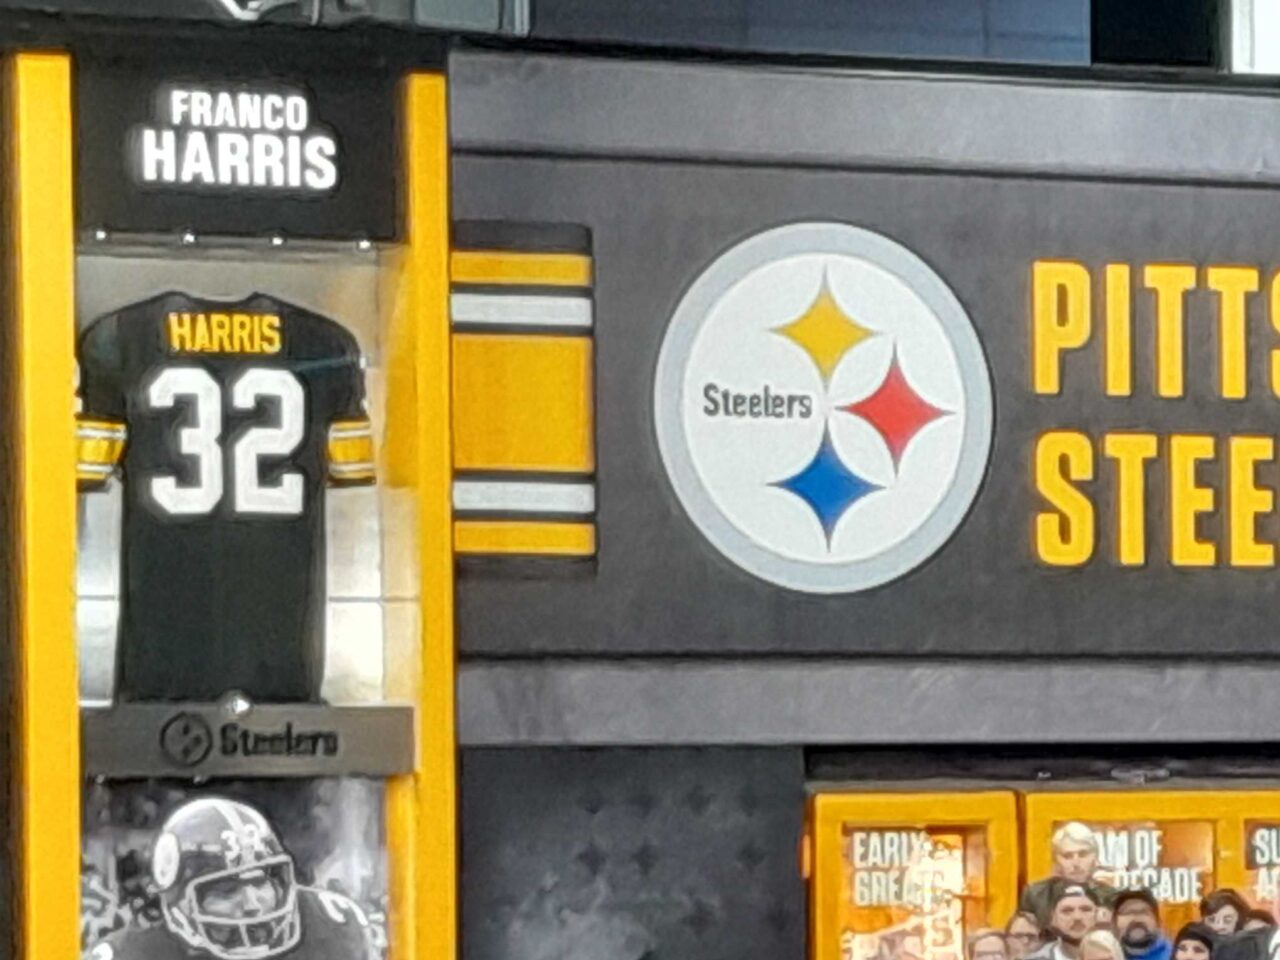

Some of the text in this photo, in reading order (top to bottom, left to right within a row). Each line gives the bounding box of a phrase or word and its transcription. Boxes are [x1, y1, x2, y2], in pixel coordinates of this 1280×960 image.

[171, 90, 308, 131] FRANCO
[143, 129, 337, 189] HARRIS
[167, 312, 282, 353] HARRIS
[703, 383, 813, 419] Steelers
[149, 366, 304, 514] 32
[219, 721, 338, 757] Steelers
[1136, 830, 1163, 867] OF
